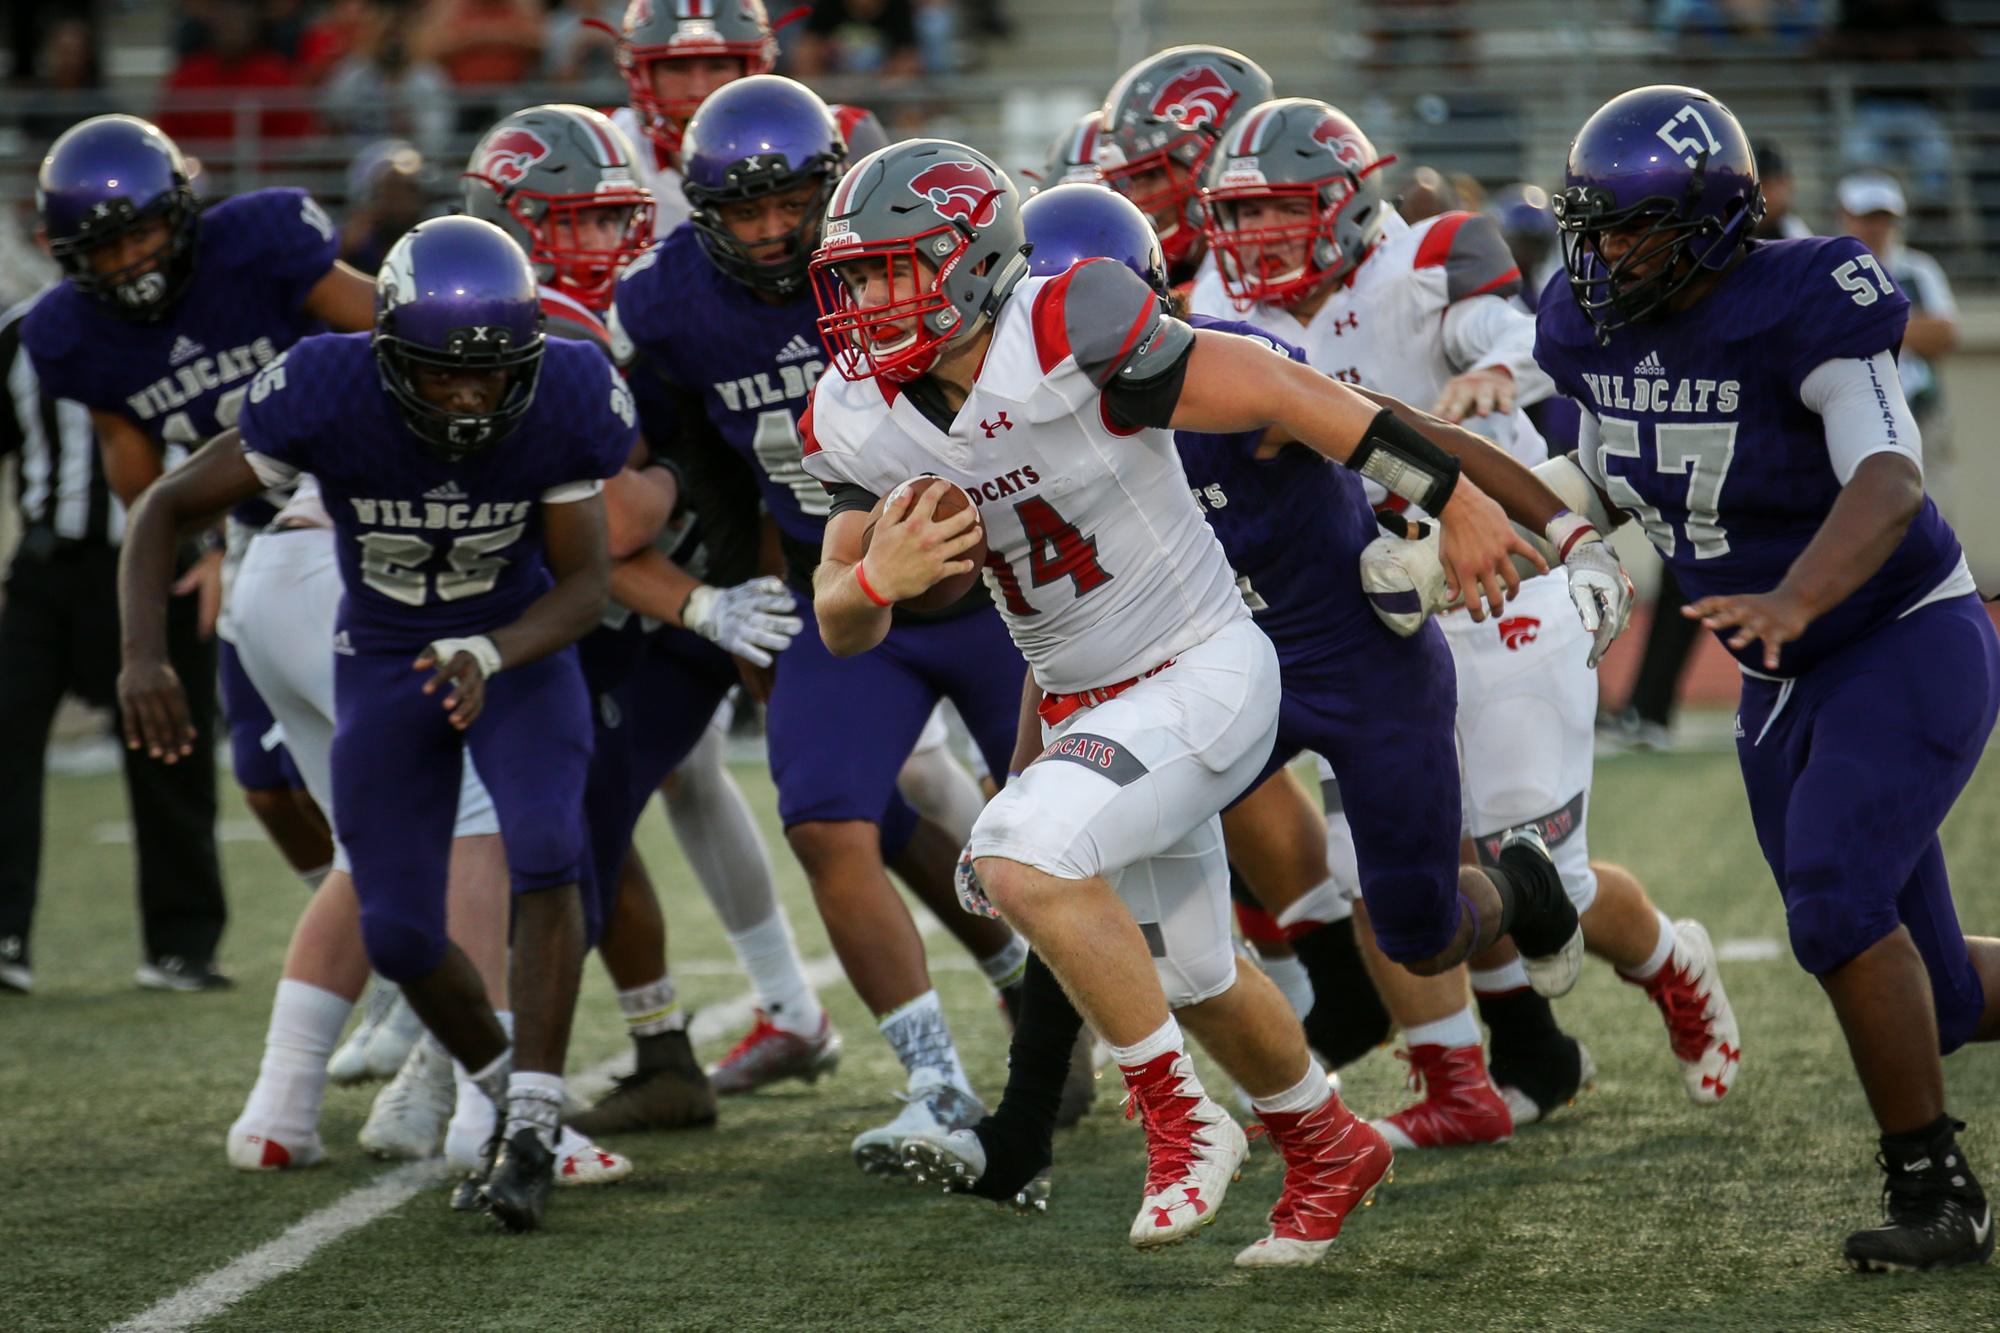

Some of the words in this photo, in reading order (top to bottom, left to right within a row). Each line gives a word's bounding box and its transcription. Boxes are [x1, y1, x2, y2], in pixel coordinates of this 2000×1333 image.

[1656, 105, 1722, 169] 57
[1831, 254, 1895, 306] 57
[126, 336, 277, 420] WILDCATS
[713, 359, 825, 412] WILDC
[1582, 373, 1741, 413] WILDCATS
[964, 465, 1041, 507] DCATS
[1597, 411, 1740, 560] 57
[350, 497, 531, 530] WILDCATS
[979, 494, 1116, 616] 14
[1047, 738, 1116, 769] DCATS
